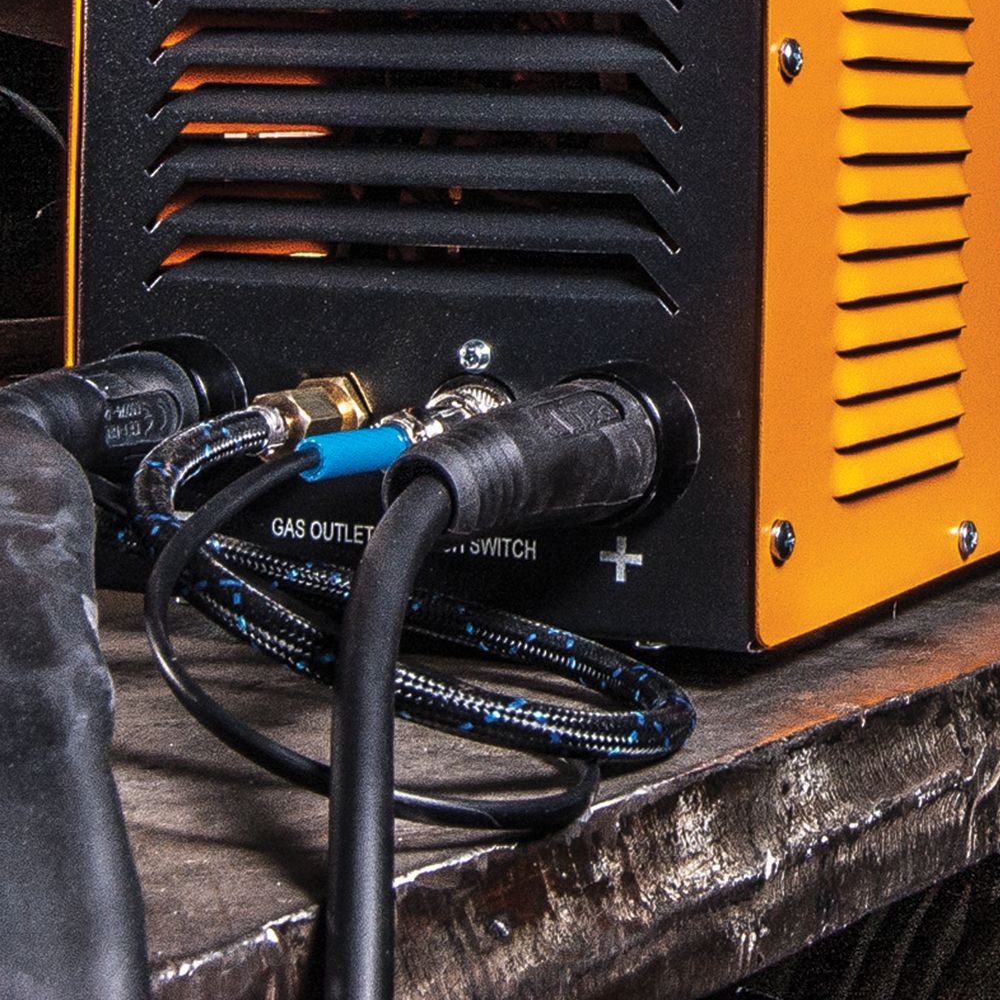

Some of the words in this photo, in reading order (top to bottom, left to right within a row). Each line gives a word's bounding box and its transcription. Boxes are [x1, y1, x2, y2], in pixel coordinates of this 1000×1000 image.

[271, 517, 305, 540] GAS
[310, 521, 375, 545] OUTLET
[470, 537, 537, 560] SWITCH
